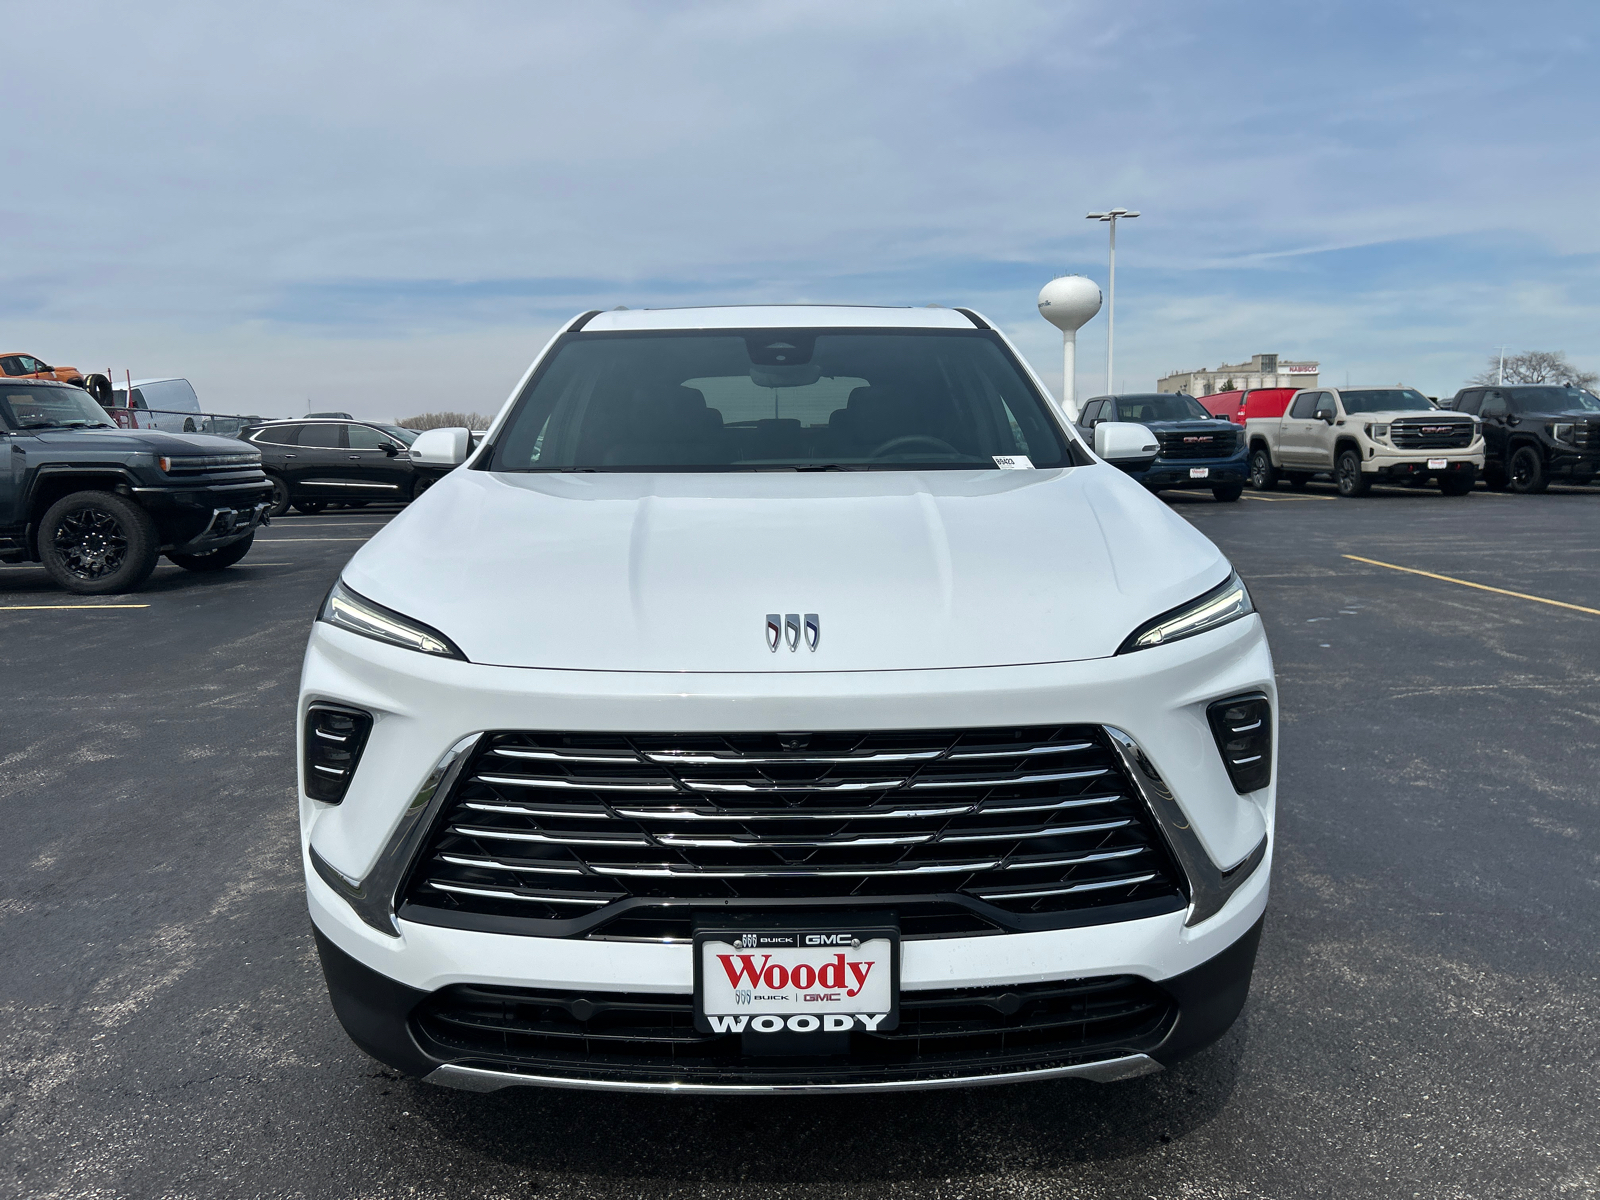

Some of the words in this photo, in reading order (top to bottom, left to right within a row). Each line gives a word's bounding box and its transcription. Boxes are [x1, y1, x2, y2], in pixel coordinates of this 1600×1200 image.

[805, 934, 852, 945] GMC
[716, 953, 875, 997] Woody
[803, 993, 841, 1002] GMC
[707, 1014, 887, 1033] WOODY
